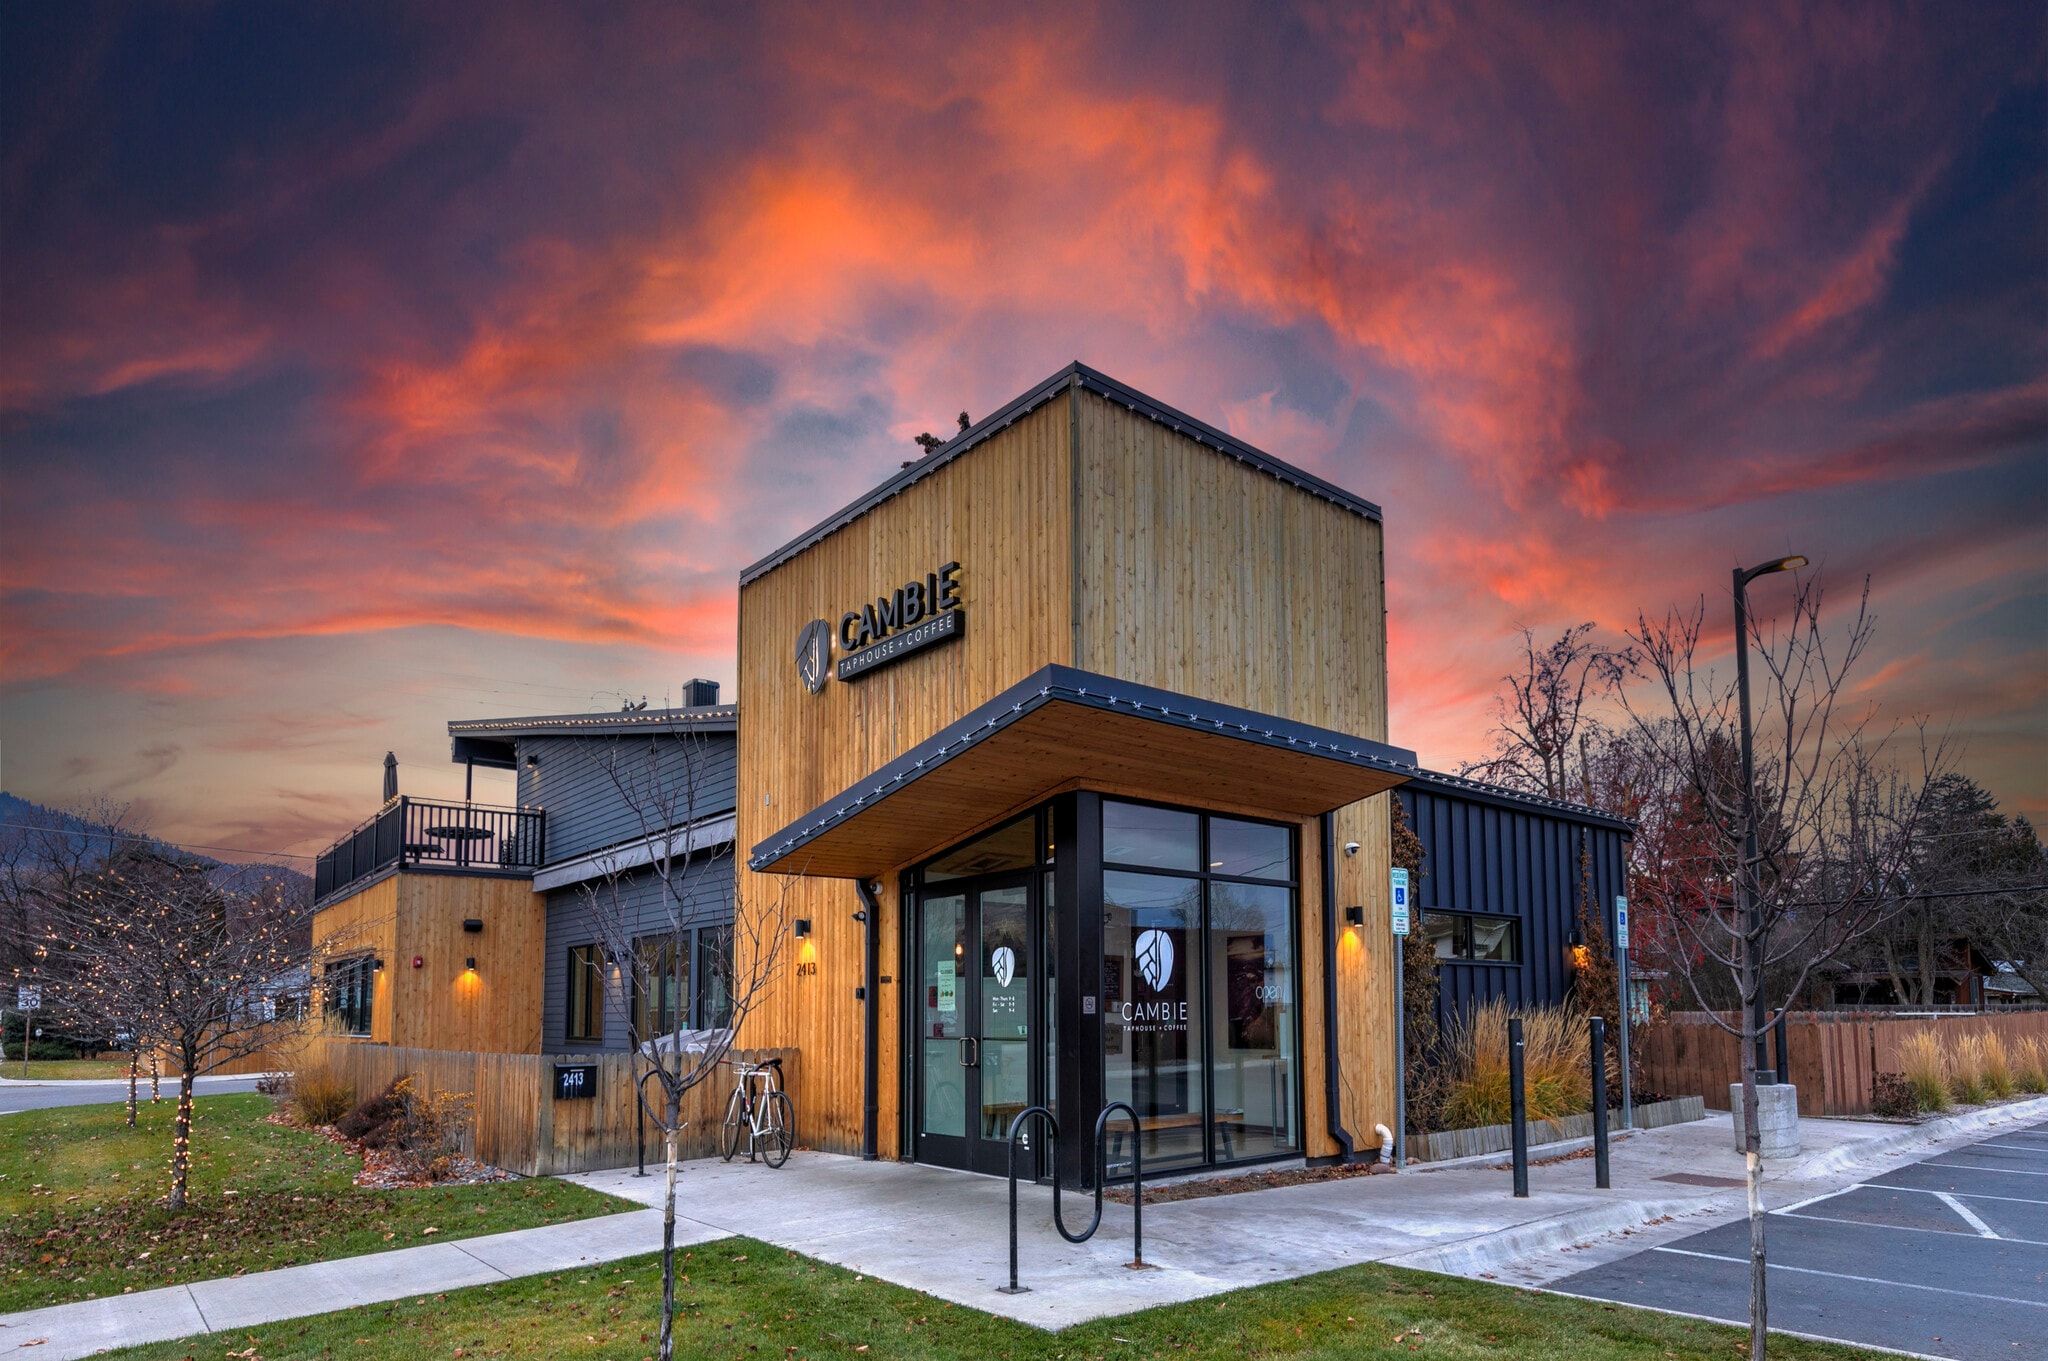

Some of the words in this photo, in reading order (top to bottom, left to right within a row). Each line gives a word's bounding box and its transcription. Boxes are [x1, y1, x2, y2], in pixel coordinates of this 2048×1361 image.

[839, 561, 961, 650] CAMBIE
[840, 641, 894, 674] TAPHOUSE
[906, 615, 952, 646] COFFEE
[796, 962, 816, 977] 2413
[1121, 1002, 1188, 1021] CAMBIE
[563, 1072, 584, 1087] 2413
